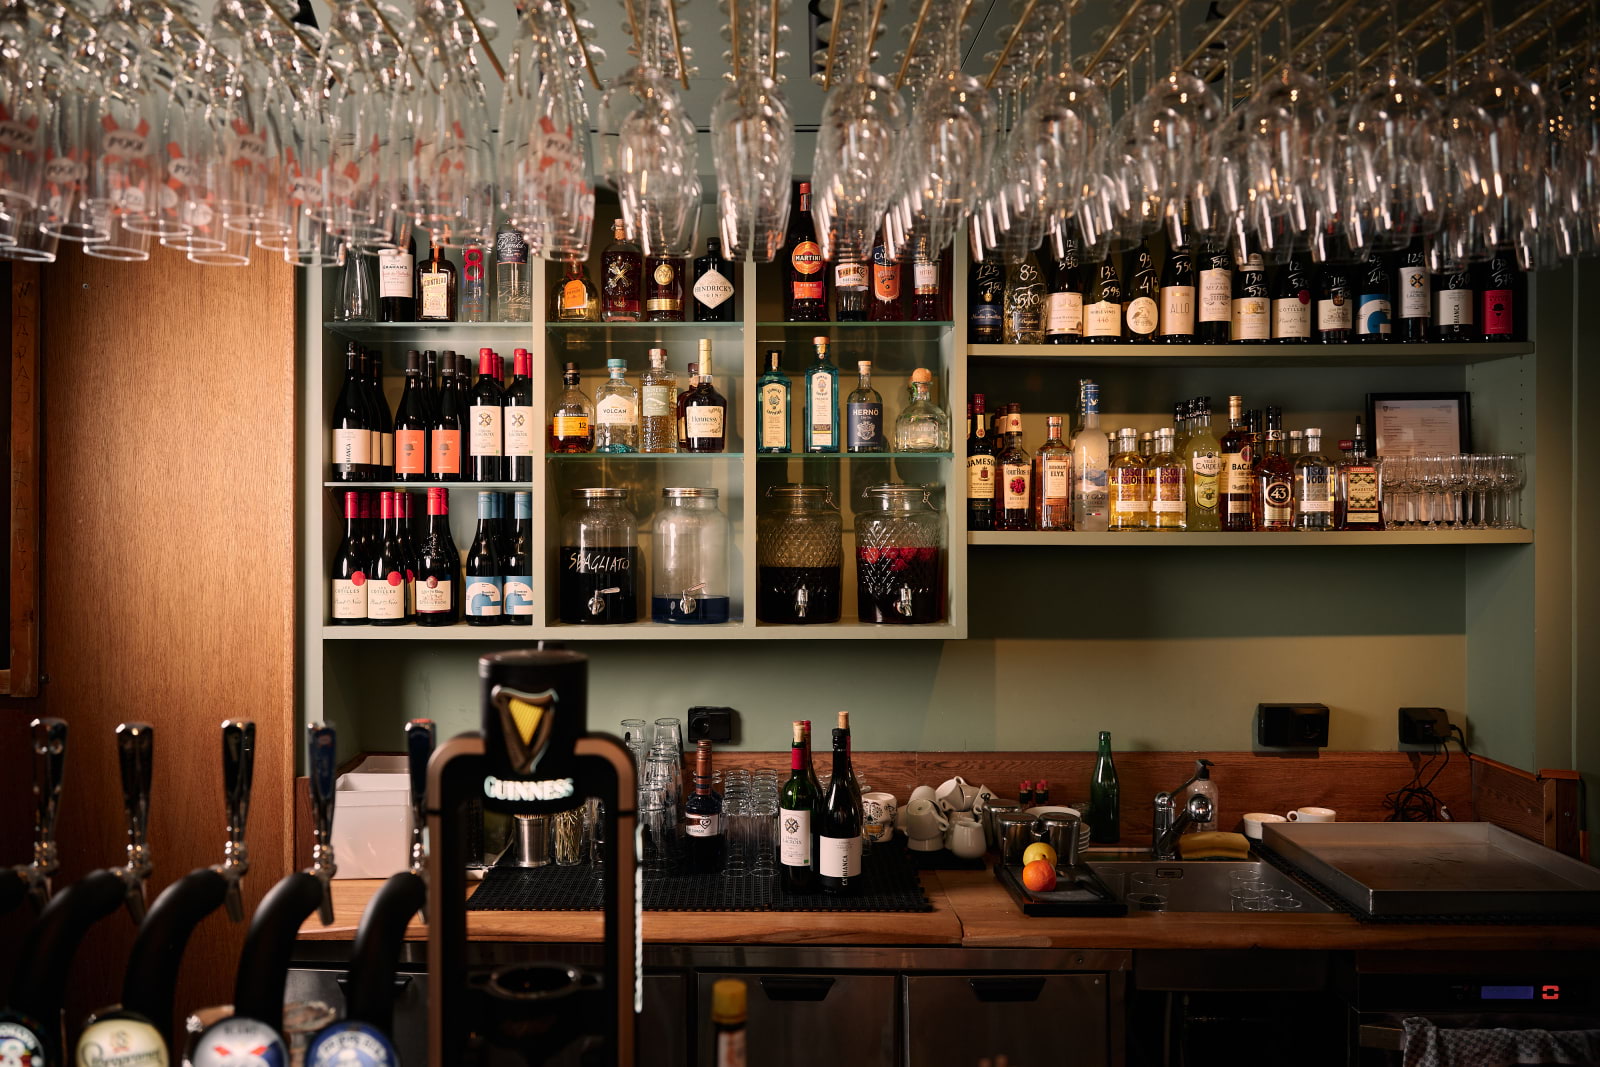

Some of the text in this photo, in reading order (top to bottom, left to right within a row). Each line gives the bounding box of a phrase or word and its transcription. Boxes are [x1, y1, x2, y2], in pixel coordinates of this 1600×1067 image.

[976, 264, 1000, 281] 125
[1019, 264, 1039, 281] 85
[1245, 272, 1263, 285] 130
[1170, 303, 1190, 313] ALLO
[852, 407, 879, 416] HERNÖ
[691, 415, 718, 424] Hennessy
[1269, 486, 1287, 500] 43
[568, 551, 631, 574] SBAGLIATO
[483, 775, 574, 801] GUINNESS
